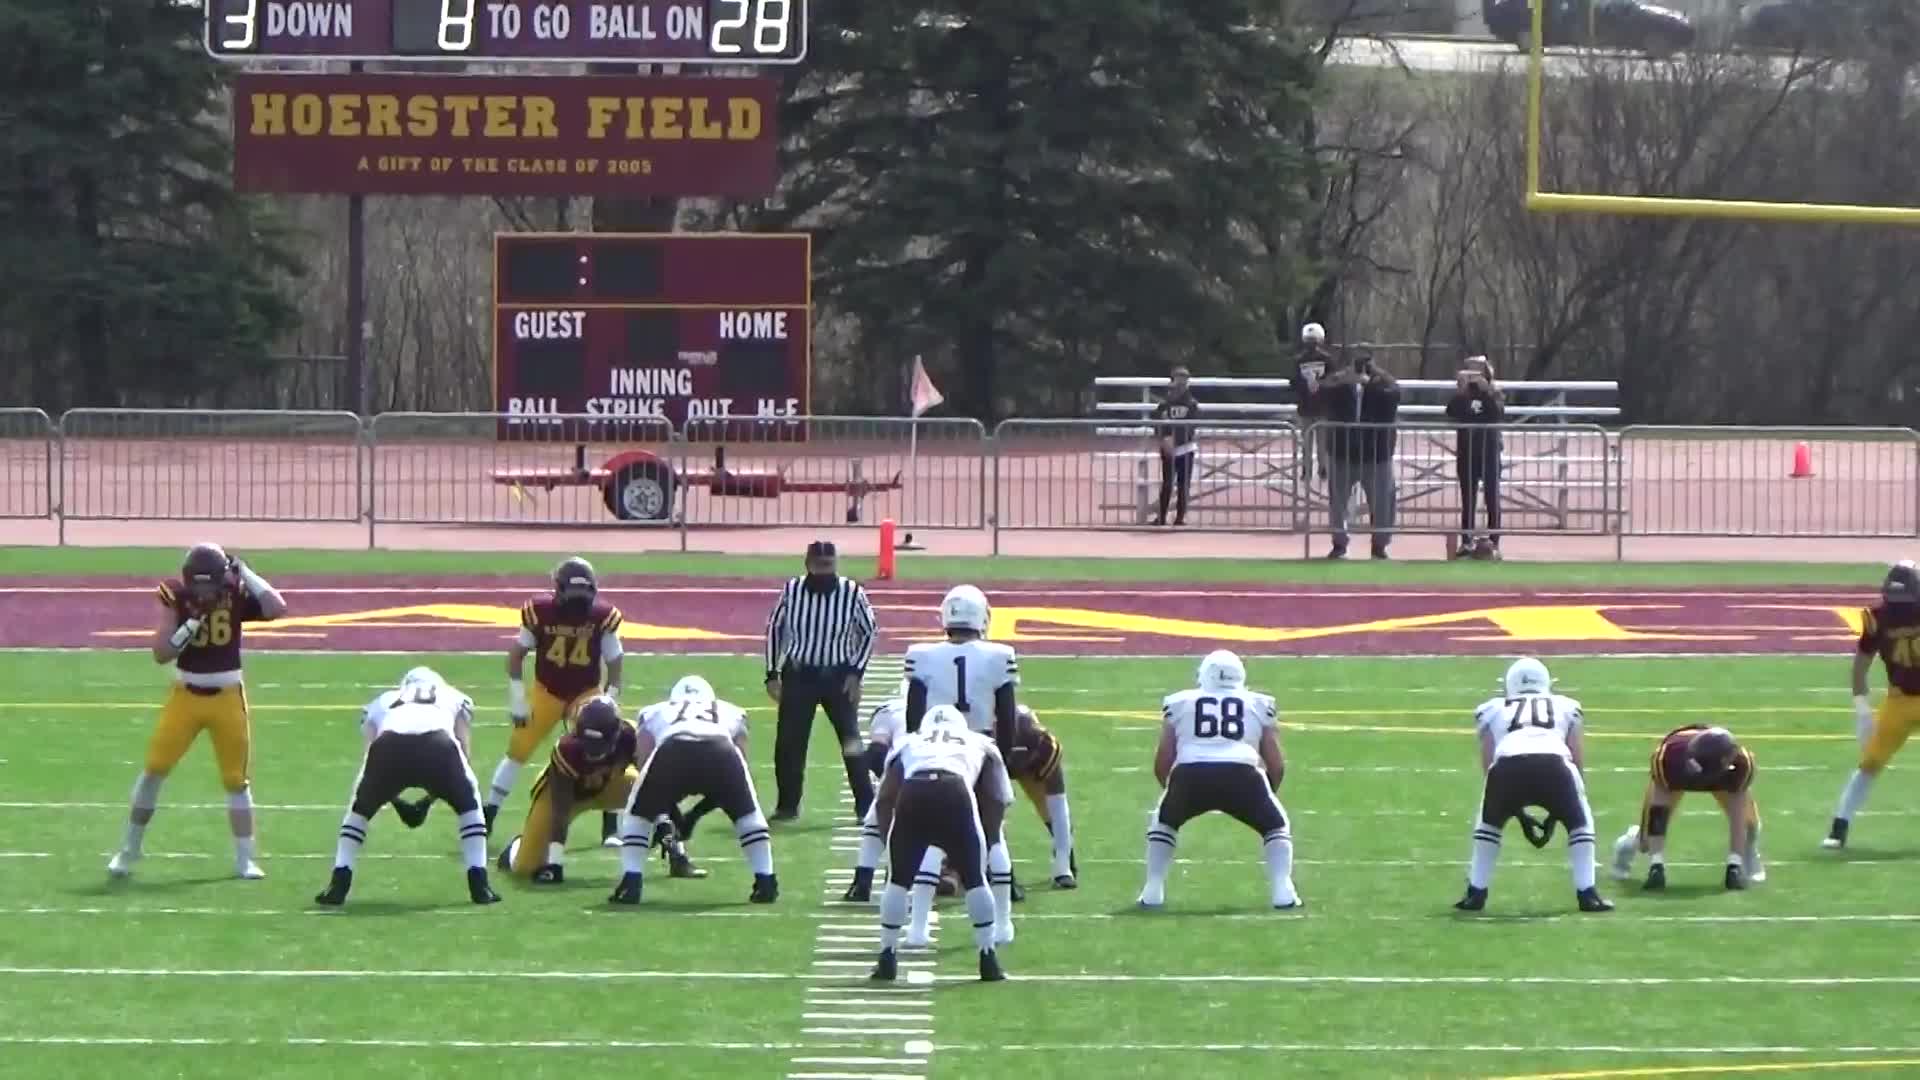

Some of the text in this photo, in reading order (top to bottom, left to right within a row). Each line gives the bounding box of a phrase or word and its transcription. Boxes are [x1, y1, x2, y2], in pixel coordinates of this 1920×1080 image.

[267, 3, 353, 37] DOWN
[488, 4, 521, 39] TO
[533, 6, 570, 40] GO
[590, 6, 656, 40] BALL
[667, 7, 703, 41] ON
[710, 0, 790, 53] 28
[250, 94, 762, 140] HOERSTER FIELD
[357, 157, 652, 174] A GIFT OF THE CLASS OF 2005
[514, 311, 788, 339] GUEST HOME
[610, 368, 693, 396] INNING
[508, 398, 563, 424] BALL
[585, 398, 666, 424] STRIKE
[687, 399, 733, 424] OUT
[545, 636, 591, 668] 44
[953, 655, 971, 712] 1
[1194, 697, 1245, 741] 68
[1504, 697, 1555, 733] 70
